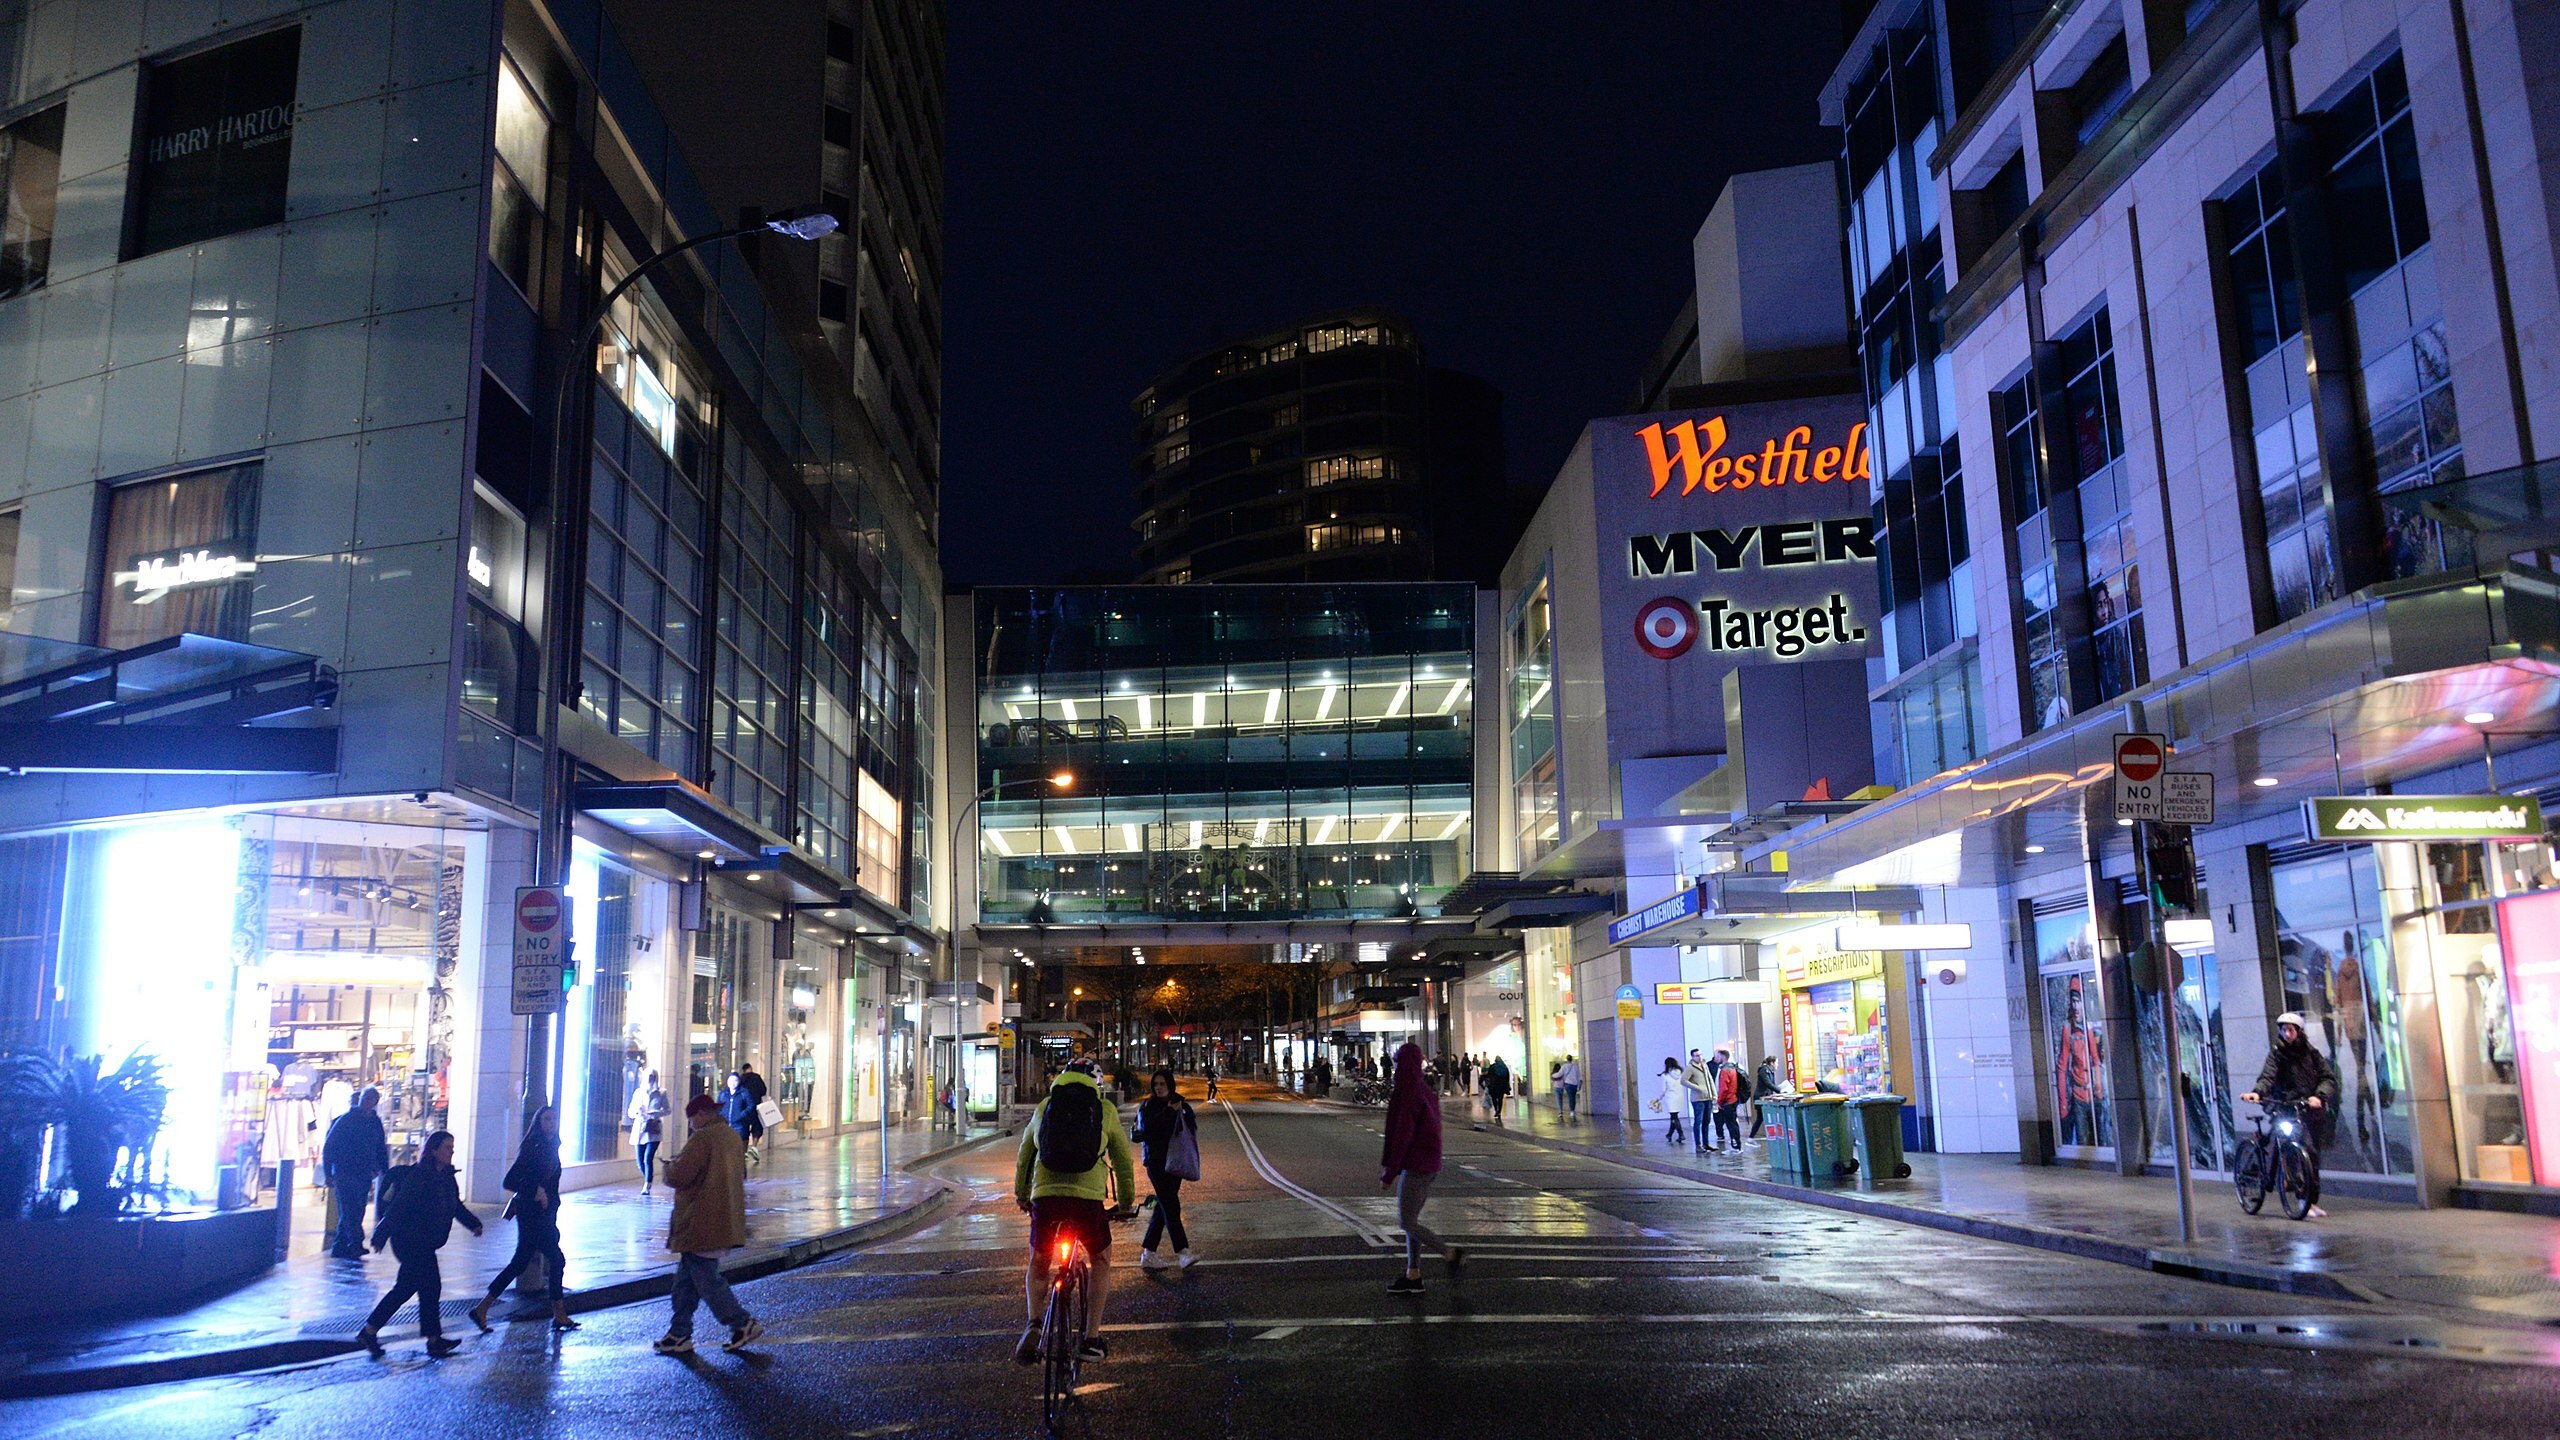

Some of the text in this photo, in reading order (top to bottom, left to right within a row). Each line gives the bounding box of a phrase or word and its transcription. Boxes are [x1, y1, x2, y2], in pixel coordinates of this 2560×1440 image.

[150, 124, 214, 162] HARRY
[1630, 517, 1877, 577] MYER
[2127, 786, 2151, 799] NO
[2118, 803, 2160, 814] ENTRY
[1617, 895, 1686, 939] CHEMIST WAREHOUSE
[526, 937, 550, 950] NO
[517, 954, 558, 965] ENTRY
[1808, 950, 1870, 976] PRESCRIPTIONS
[1783, 998, 1791, 1031] OPEN
[1785, 1036, 1792, 1049] 7
